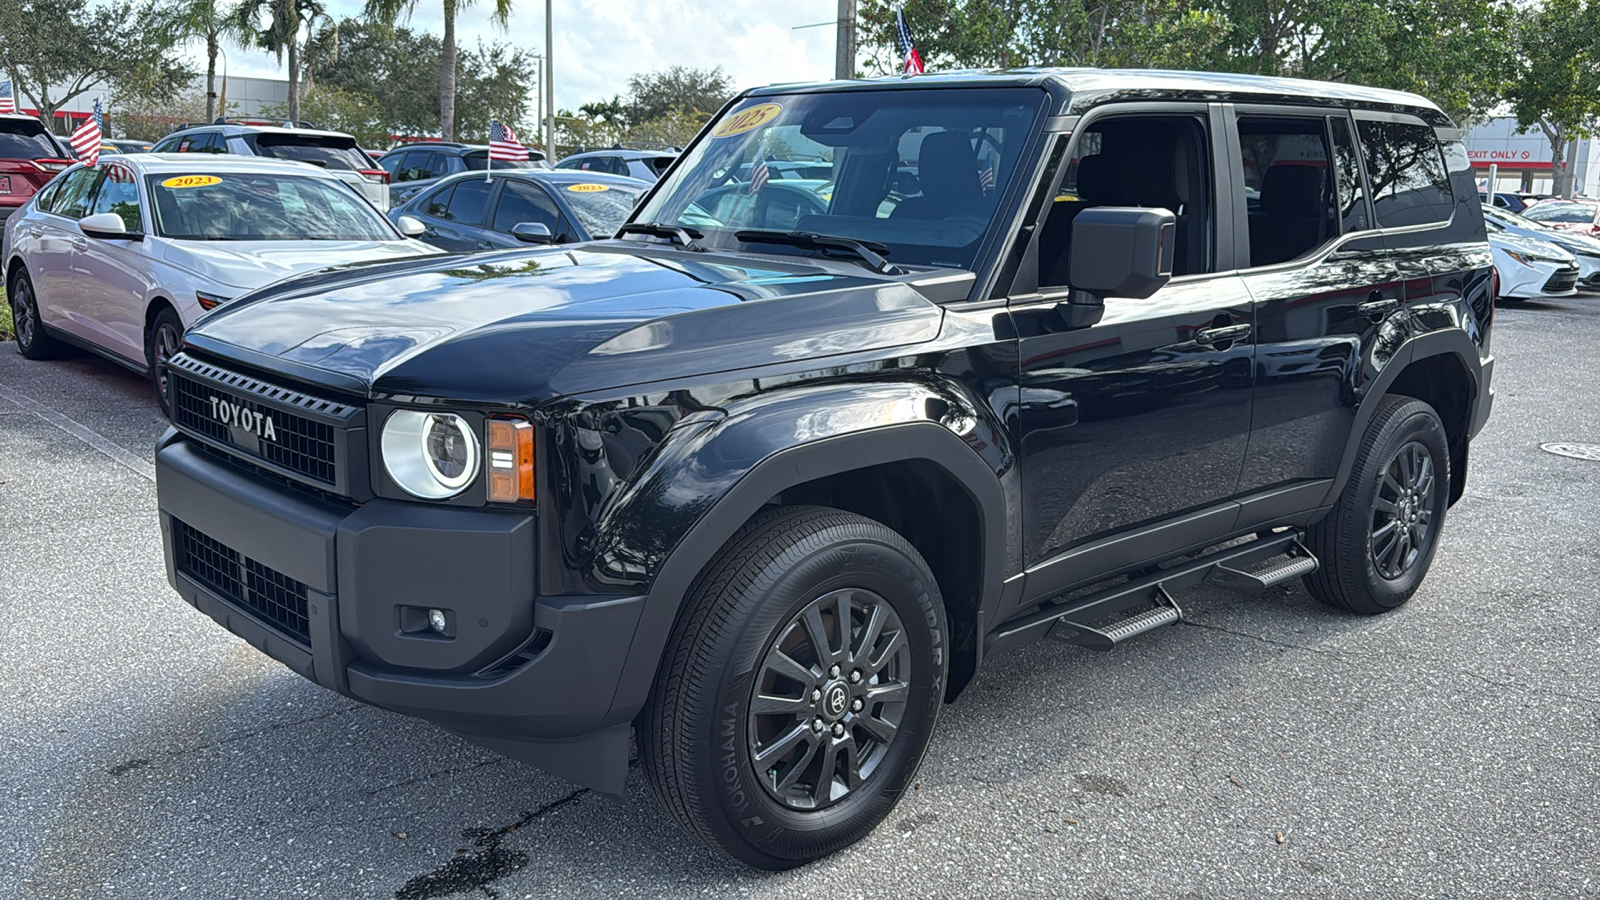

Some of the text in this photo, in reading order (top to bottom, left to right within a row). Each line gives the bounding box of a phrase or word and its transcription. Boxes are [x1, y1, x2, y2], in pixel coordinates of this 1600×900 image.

[716, 106, 775, 135] 2025
[1467, 150, 1518, 159] EXIT ONLY
[174, 176, 213, 187] 2023
[209, 395, 277, 442] TOYOTA
[720, 701, 750, 818] YOKOHAMA
